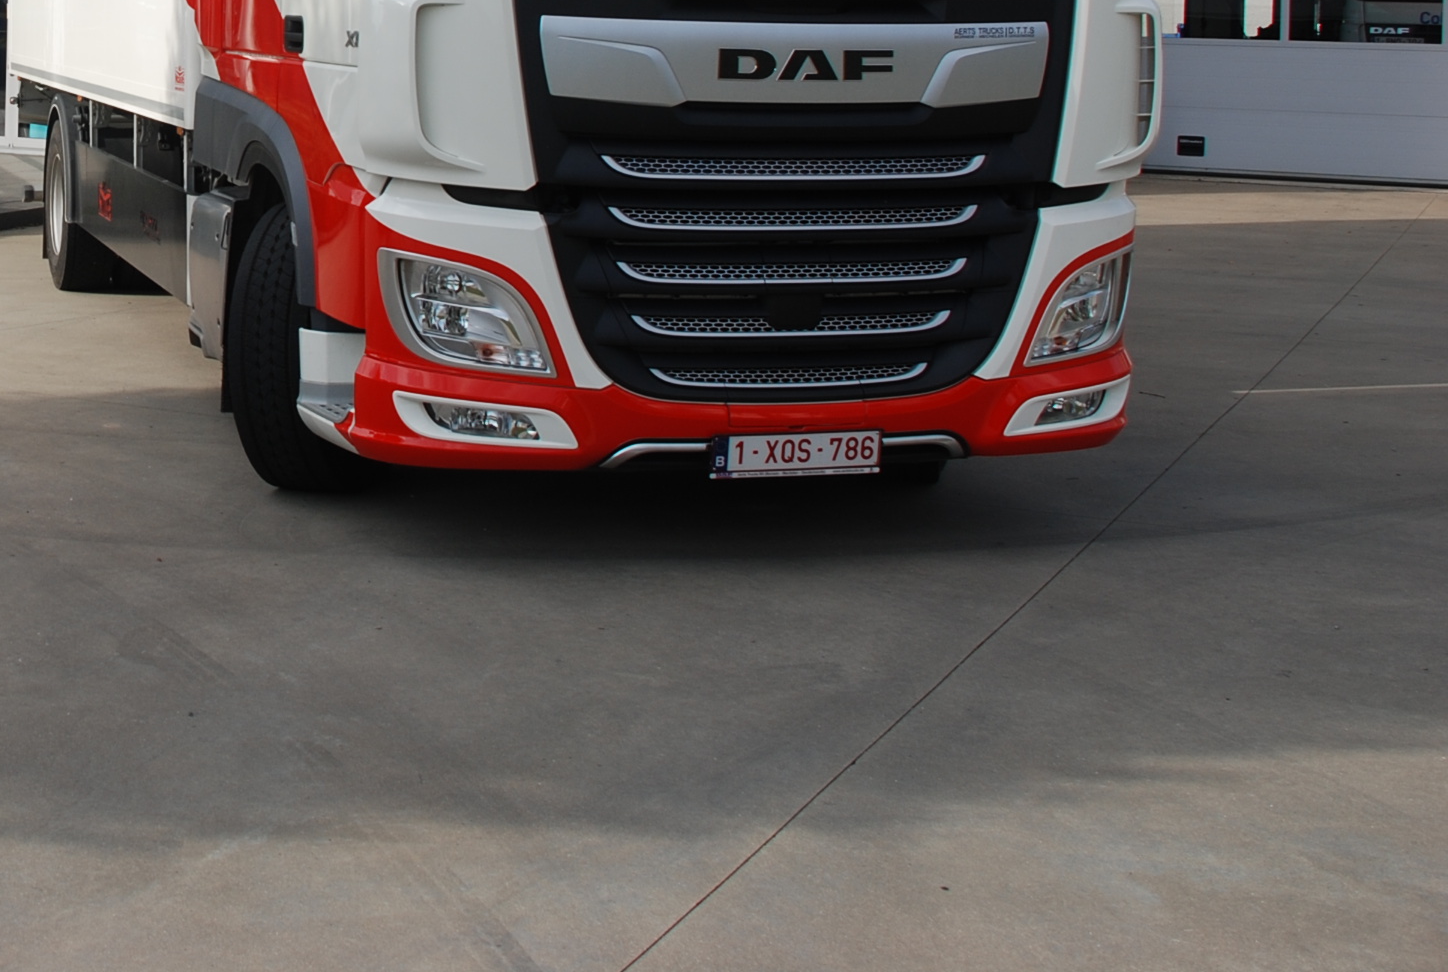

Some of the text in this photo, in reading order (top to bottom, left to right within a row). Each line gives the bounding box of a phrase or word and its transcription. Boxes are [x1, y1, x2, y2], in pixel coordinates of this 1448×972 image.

[718, 48, 894, 81] DAF
[715, 455, 725, 467] B
[735, 436, 875, 465] 1-XQS-786
